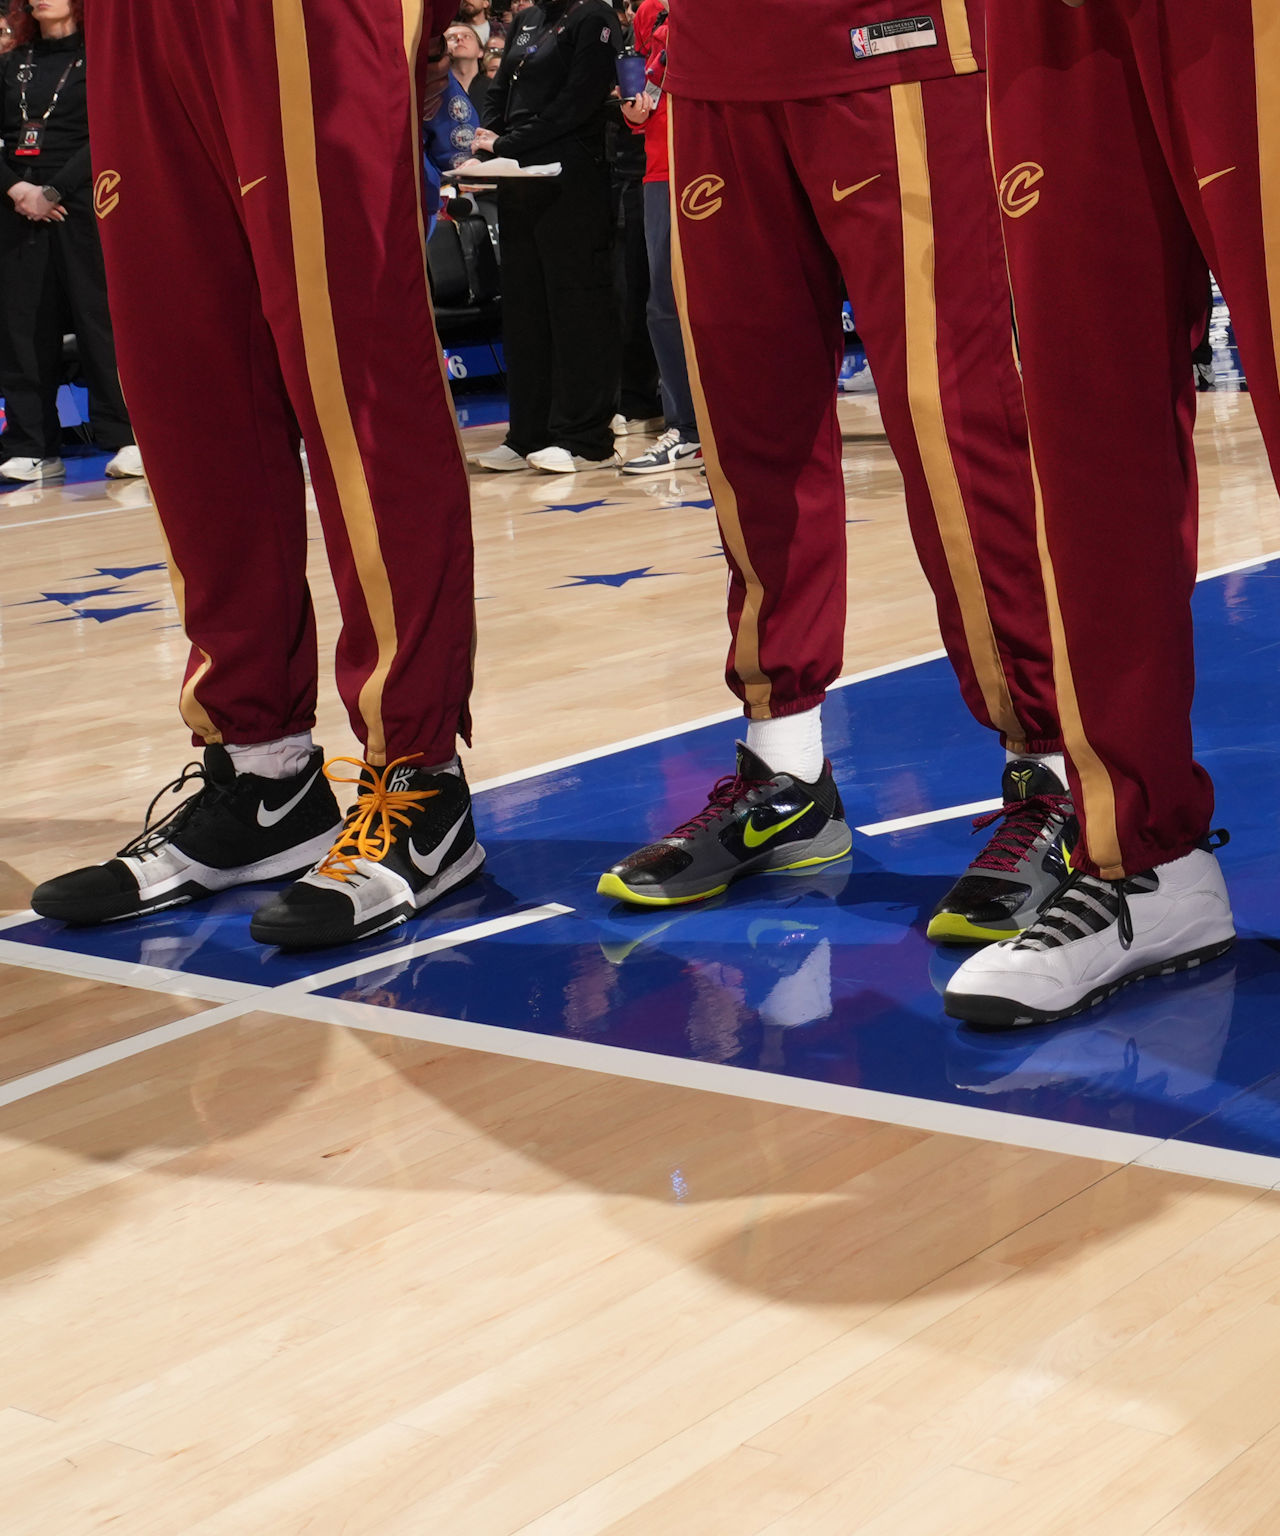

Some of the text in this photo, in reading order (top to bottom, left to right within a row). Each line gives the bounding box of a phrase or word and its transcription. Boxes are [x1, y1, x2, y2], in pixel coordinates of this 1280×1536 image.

[93, 169, 121, 219] C
[681, 173, 725, 220] C
[999, 161, 1045, 218] C
[444, 355, 468, 379] 6
